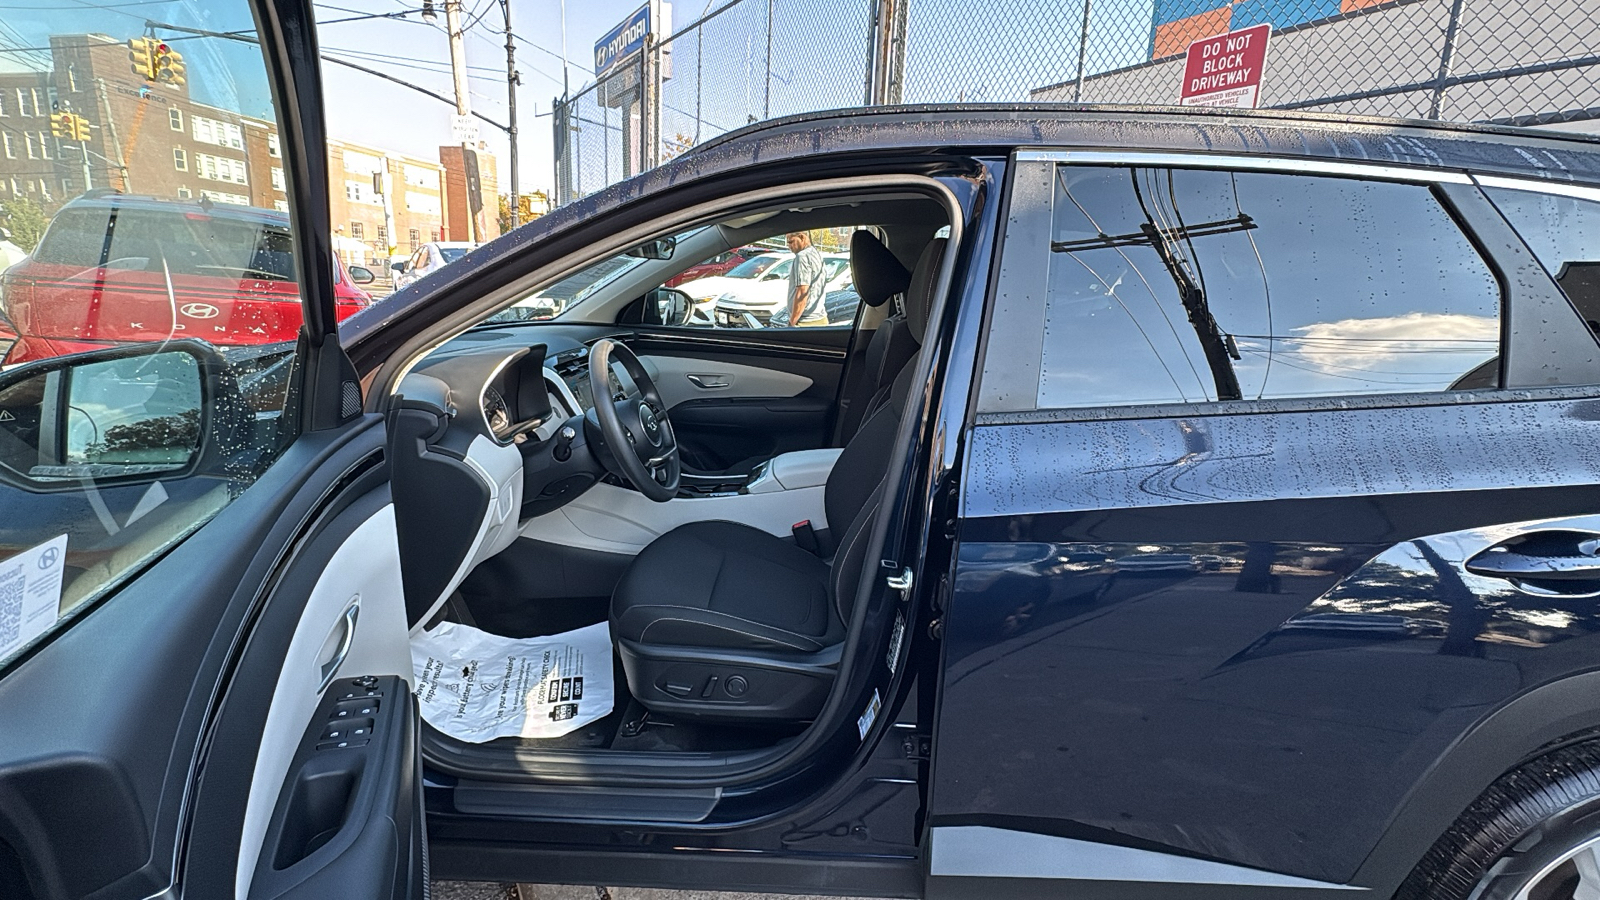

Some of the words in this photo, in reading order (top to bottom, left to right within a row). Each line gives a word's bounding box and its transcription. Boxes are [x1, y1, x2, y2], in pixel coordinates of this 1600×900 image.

[608, 18, 646, 59] HYUNDAI
[1202, 42, 1221, 59] DO
[1226, 34, 1253, 53] NOT
[1202, 52, 1245, 74] BLOCK
[1191, 67, 1252, 93] DRIVEWAY
[1188, 93, 1224, 105] UNAUTHORIZED
[1224, 88, 1249, 98] VEHICLES
[1218, 96, 1240, 106] VEHICLE
[130, 322, 265, 334] KONA
[541, 663, 550, 680] SAFETY
[498, 695, 507, 709] your
